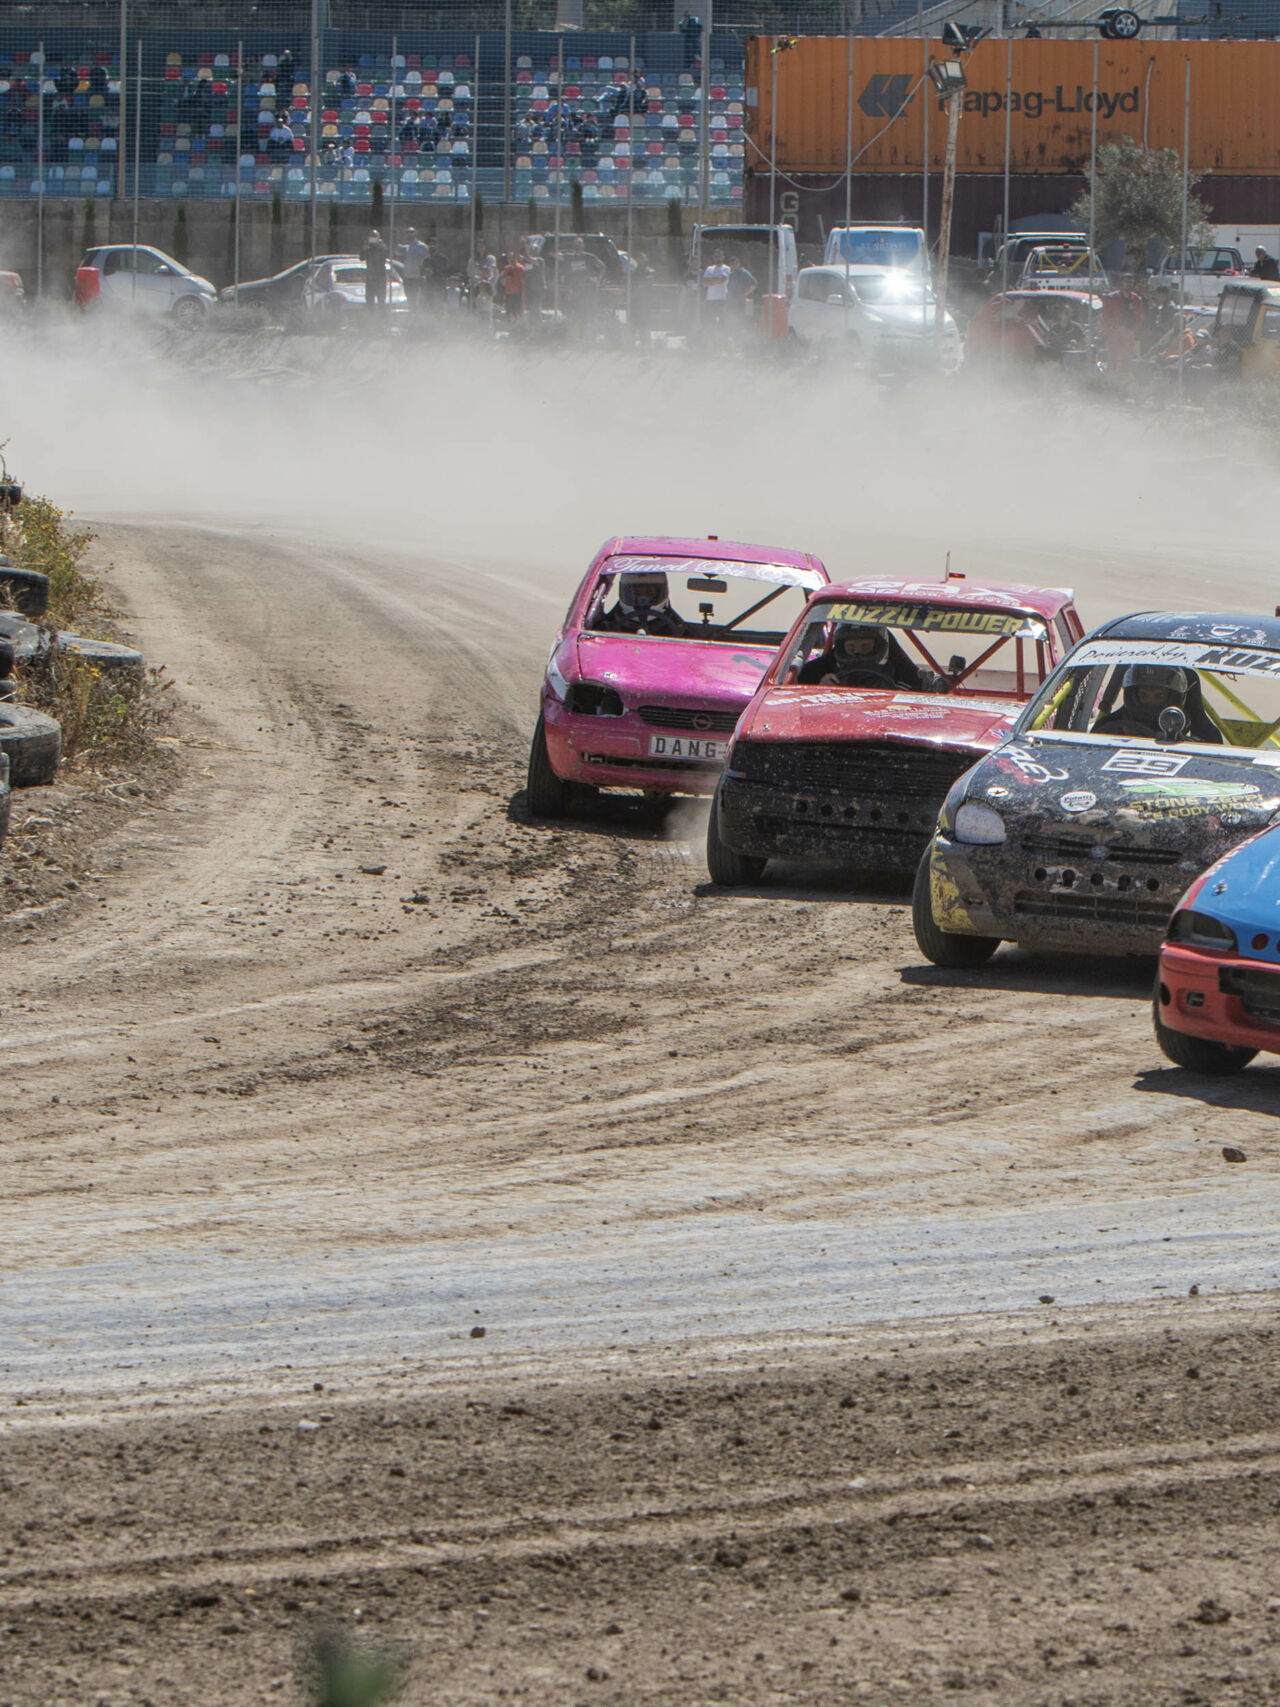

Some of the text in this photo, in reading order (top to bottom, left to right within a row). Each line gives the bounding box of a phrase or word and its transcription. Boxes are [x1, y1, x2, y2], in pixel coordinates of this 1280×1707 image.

[938, 85, 1140, 119] apag-Lloyd
[826, 604, 1024, 633] KUZZU POWER
[1081, 645, 1156, 661] Powered
[1108, 757, 1178, 773] 29
[1129, 796, 1200, 812] STONE
